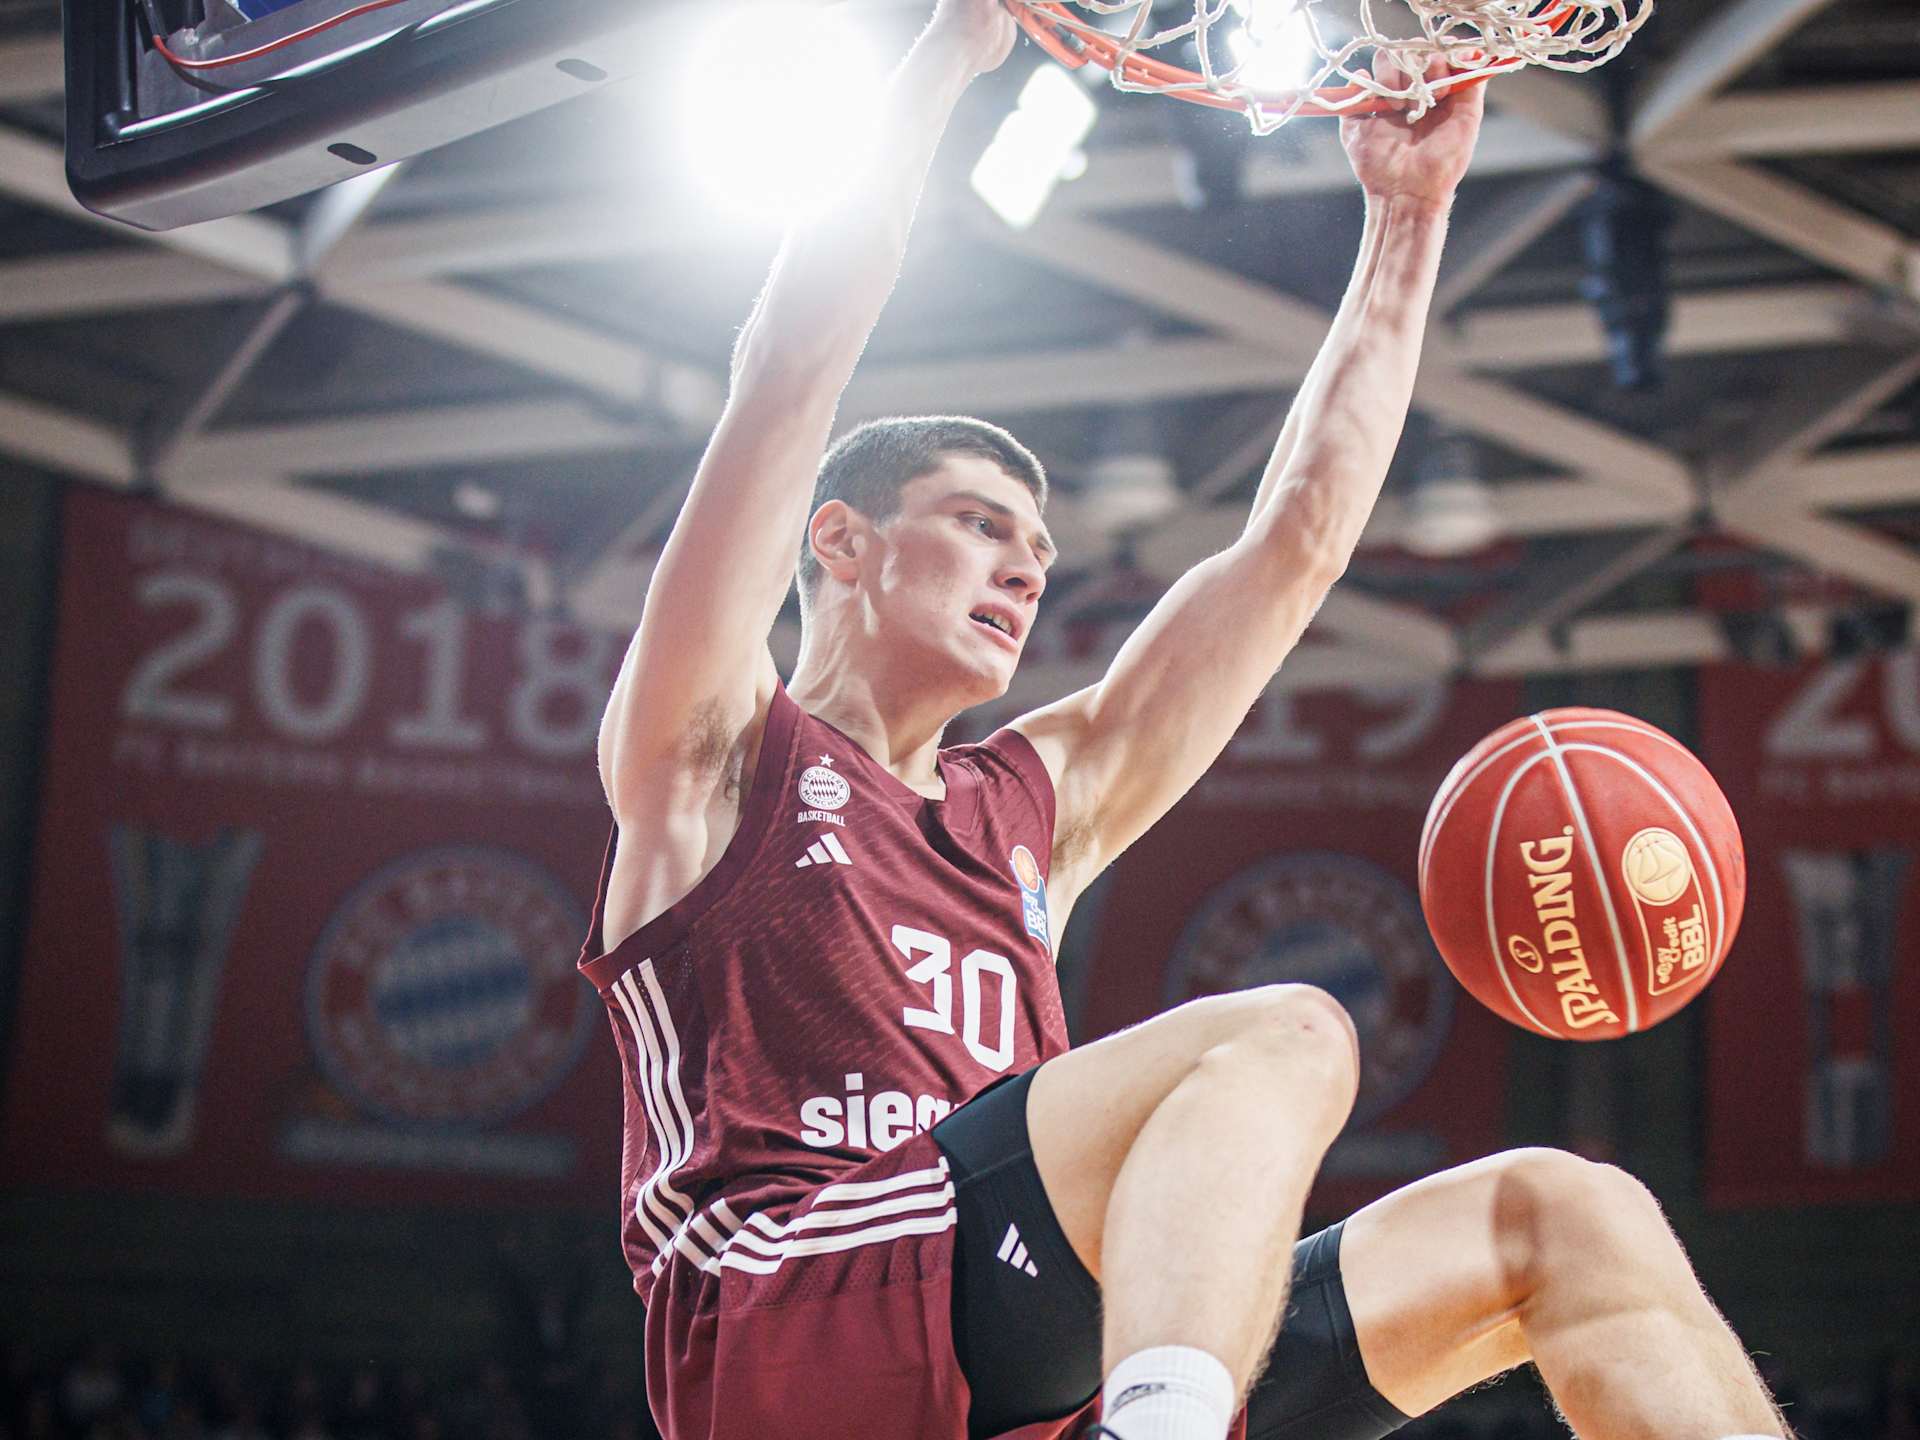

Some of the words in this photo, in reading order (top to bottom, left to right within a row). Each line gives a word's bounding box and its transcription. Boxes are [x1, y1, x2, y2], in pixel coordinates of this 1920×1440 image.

[123, 570, 612, 758] 2018
[797, 810, 846, 827] BASKETBALL
[1678, 904, 1705, 970] BBL
[891, 925, 1017, 1072] 30
